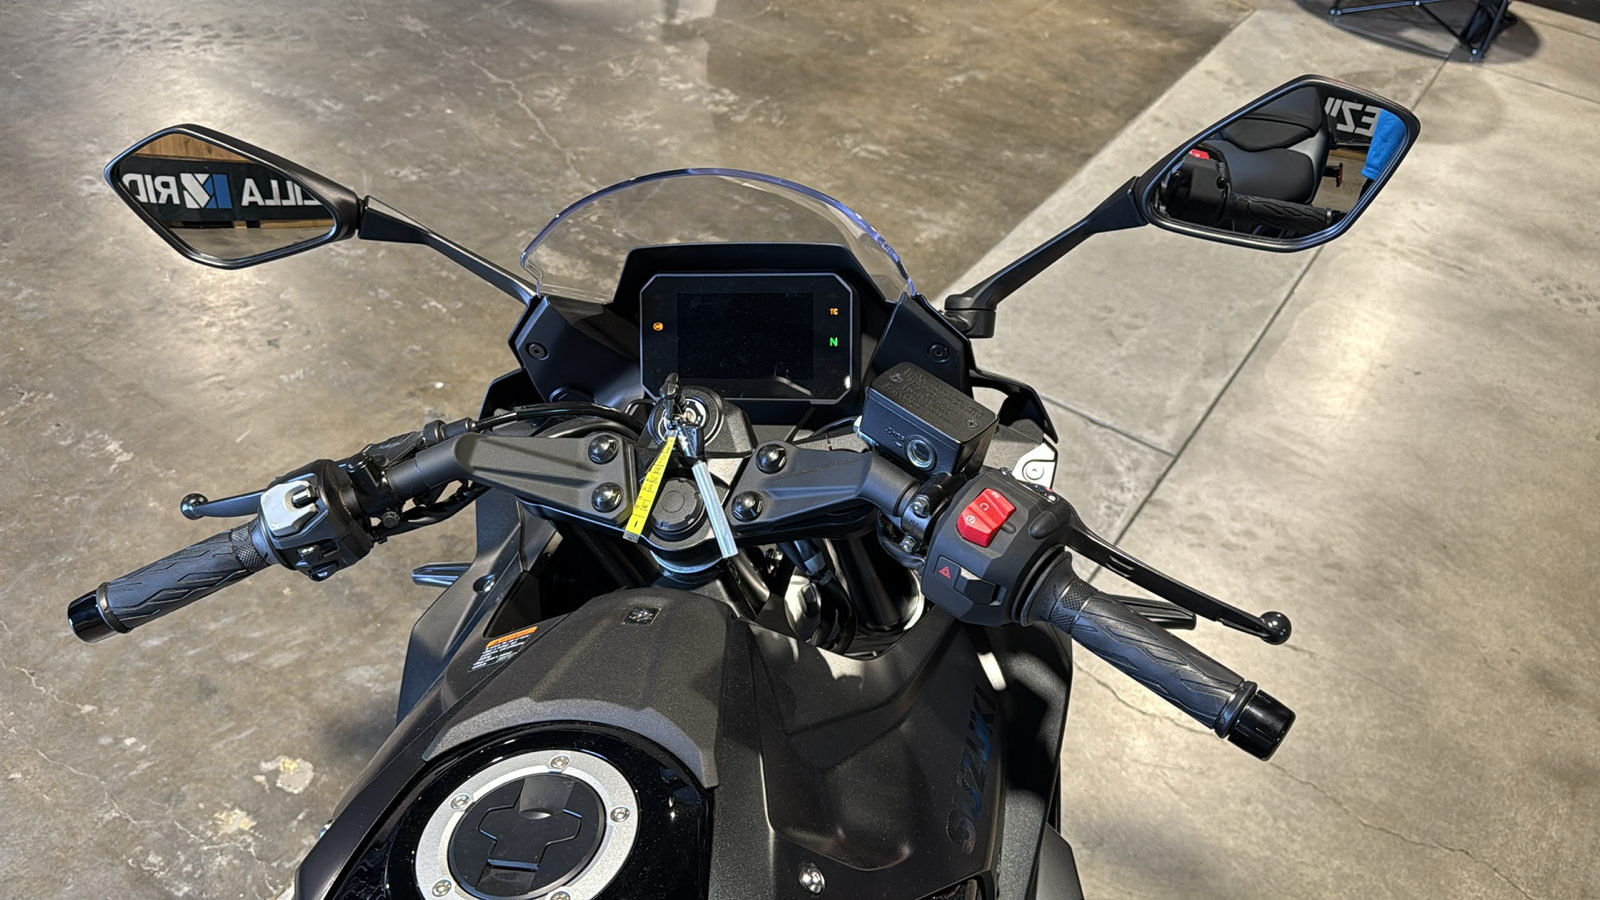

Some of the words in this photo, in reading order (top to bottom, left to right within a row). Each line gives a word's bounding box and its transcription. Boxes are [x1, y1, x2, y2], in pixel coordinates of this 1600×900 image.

[829, 307, 839, 315] TC
[829, 337, 838, 347] N
[946, 684, 997, 854] SUZUKI
